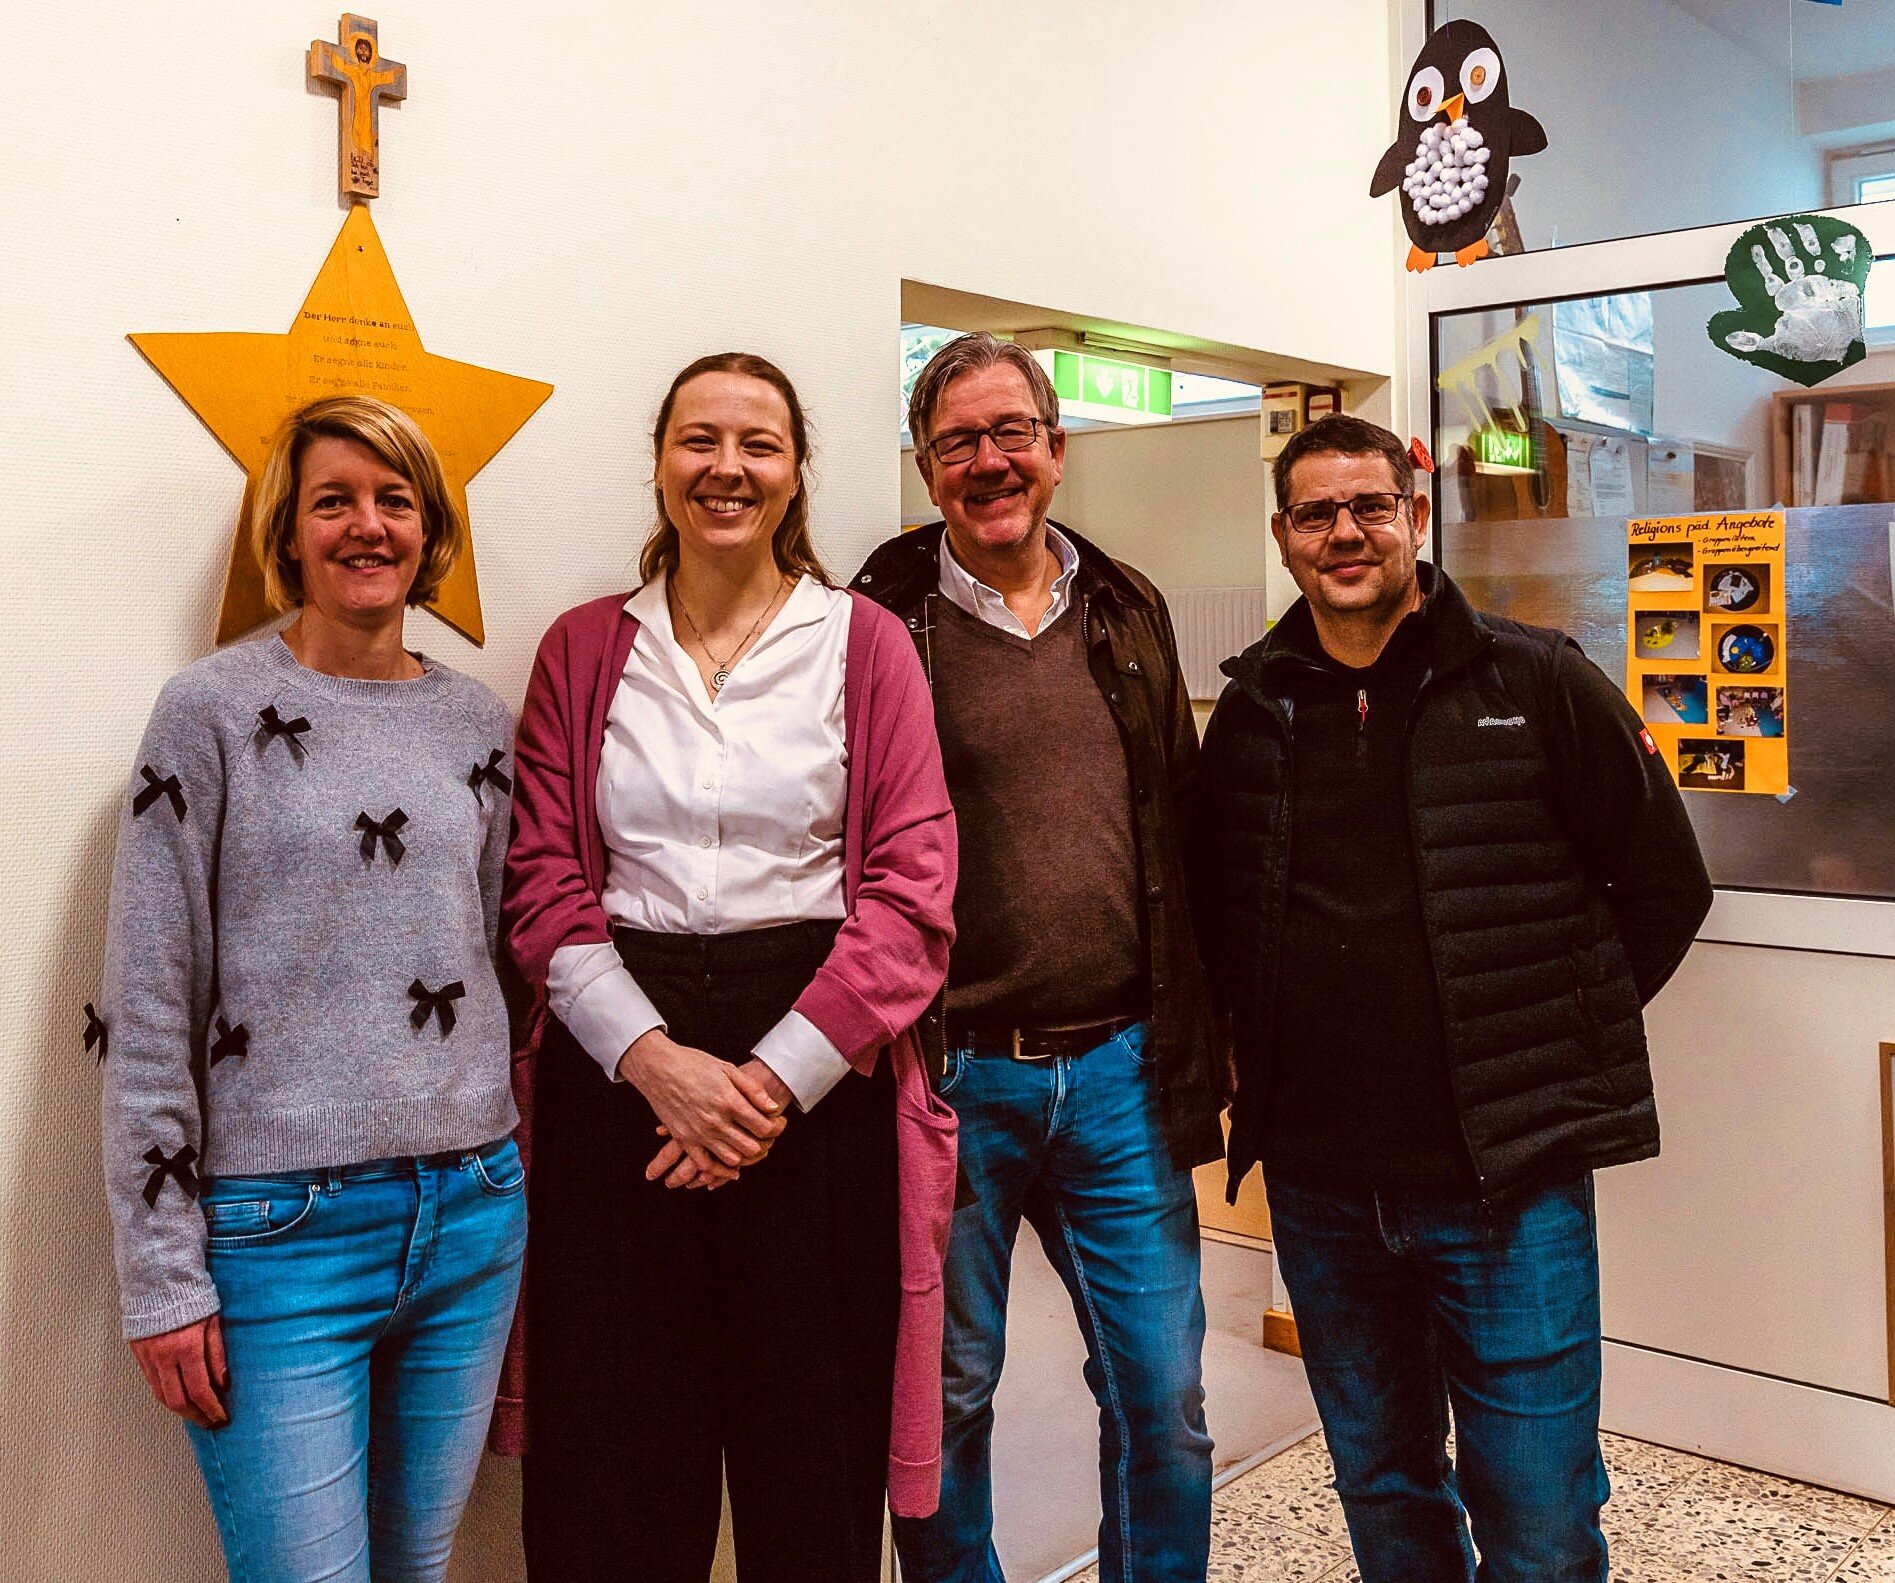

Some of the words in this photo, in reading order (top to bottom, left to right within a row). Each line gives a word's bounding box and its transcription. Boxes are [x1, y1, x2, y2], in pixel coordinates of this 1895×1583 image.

[304, 311, 322, 321] Der
[323, 313, 347, 324] Herr
[348, 315, 377, 327] denke
[379, 320, 390, 329] an
[313, 354, 325, 363] Er
[1631, 521, 1682, 542] Religions
[1686, 519, 1712, 539] päd.
[1716, 515, 1776, 538] Angebote
